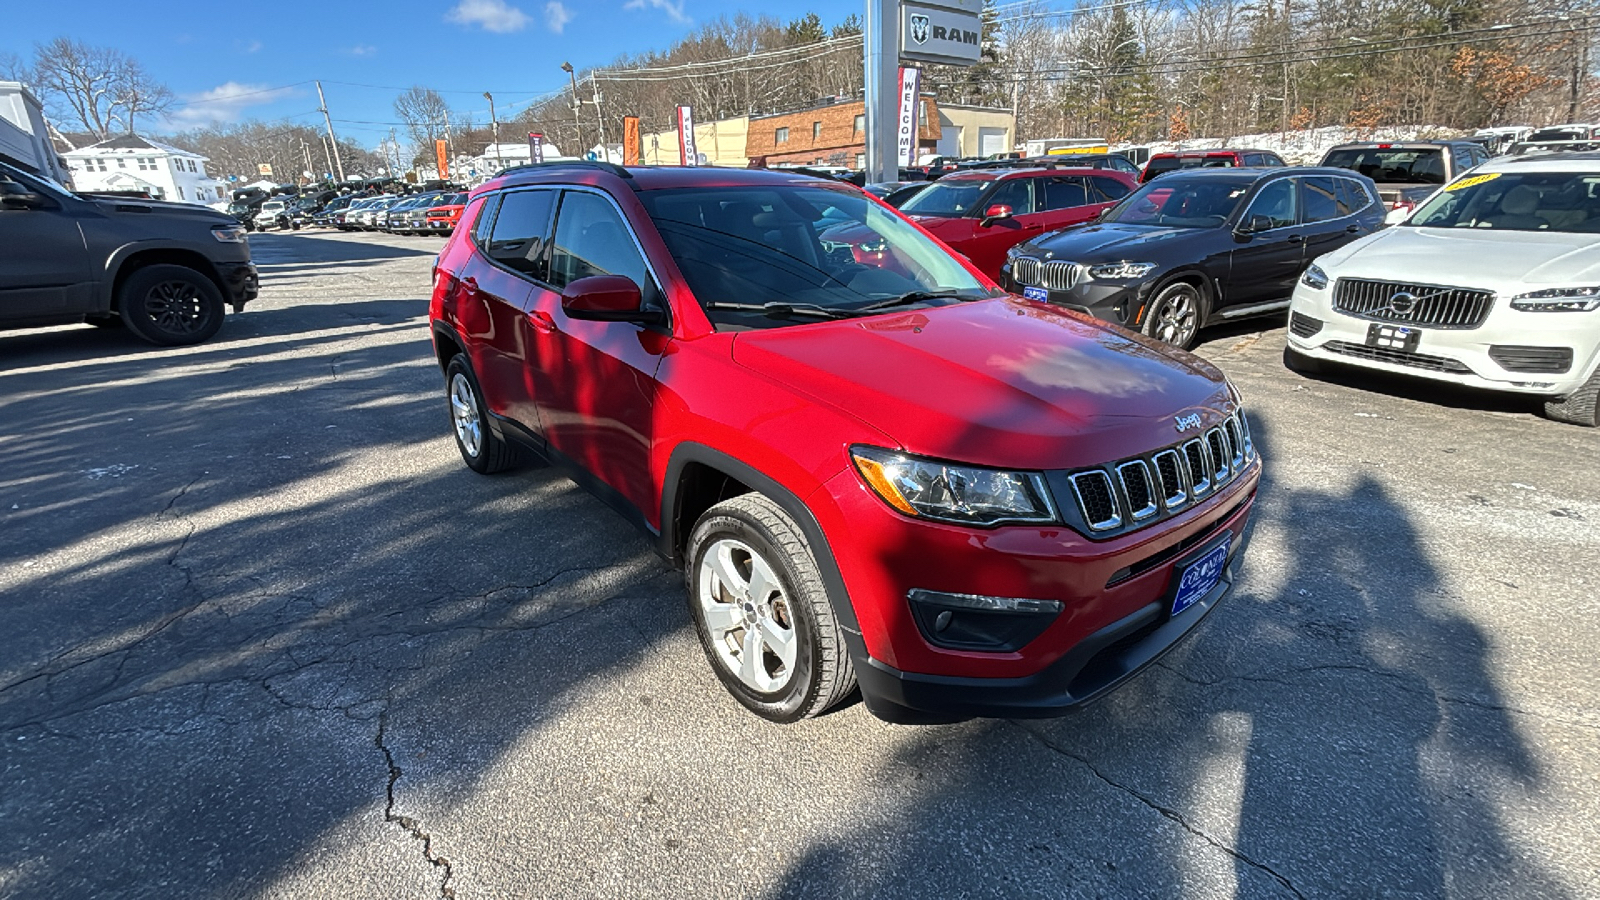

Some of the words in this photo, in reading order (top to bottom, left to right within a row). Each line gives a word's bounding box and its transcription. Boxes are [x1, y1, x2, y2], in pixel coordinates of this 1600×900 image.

[933, 25, 978, 46] RAM
[899, 81, 914, 156] WELCOME
[1174, 413, 1202, 432] Jeep
